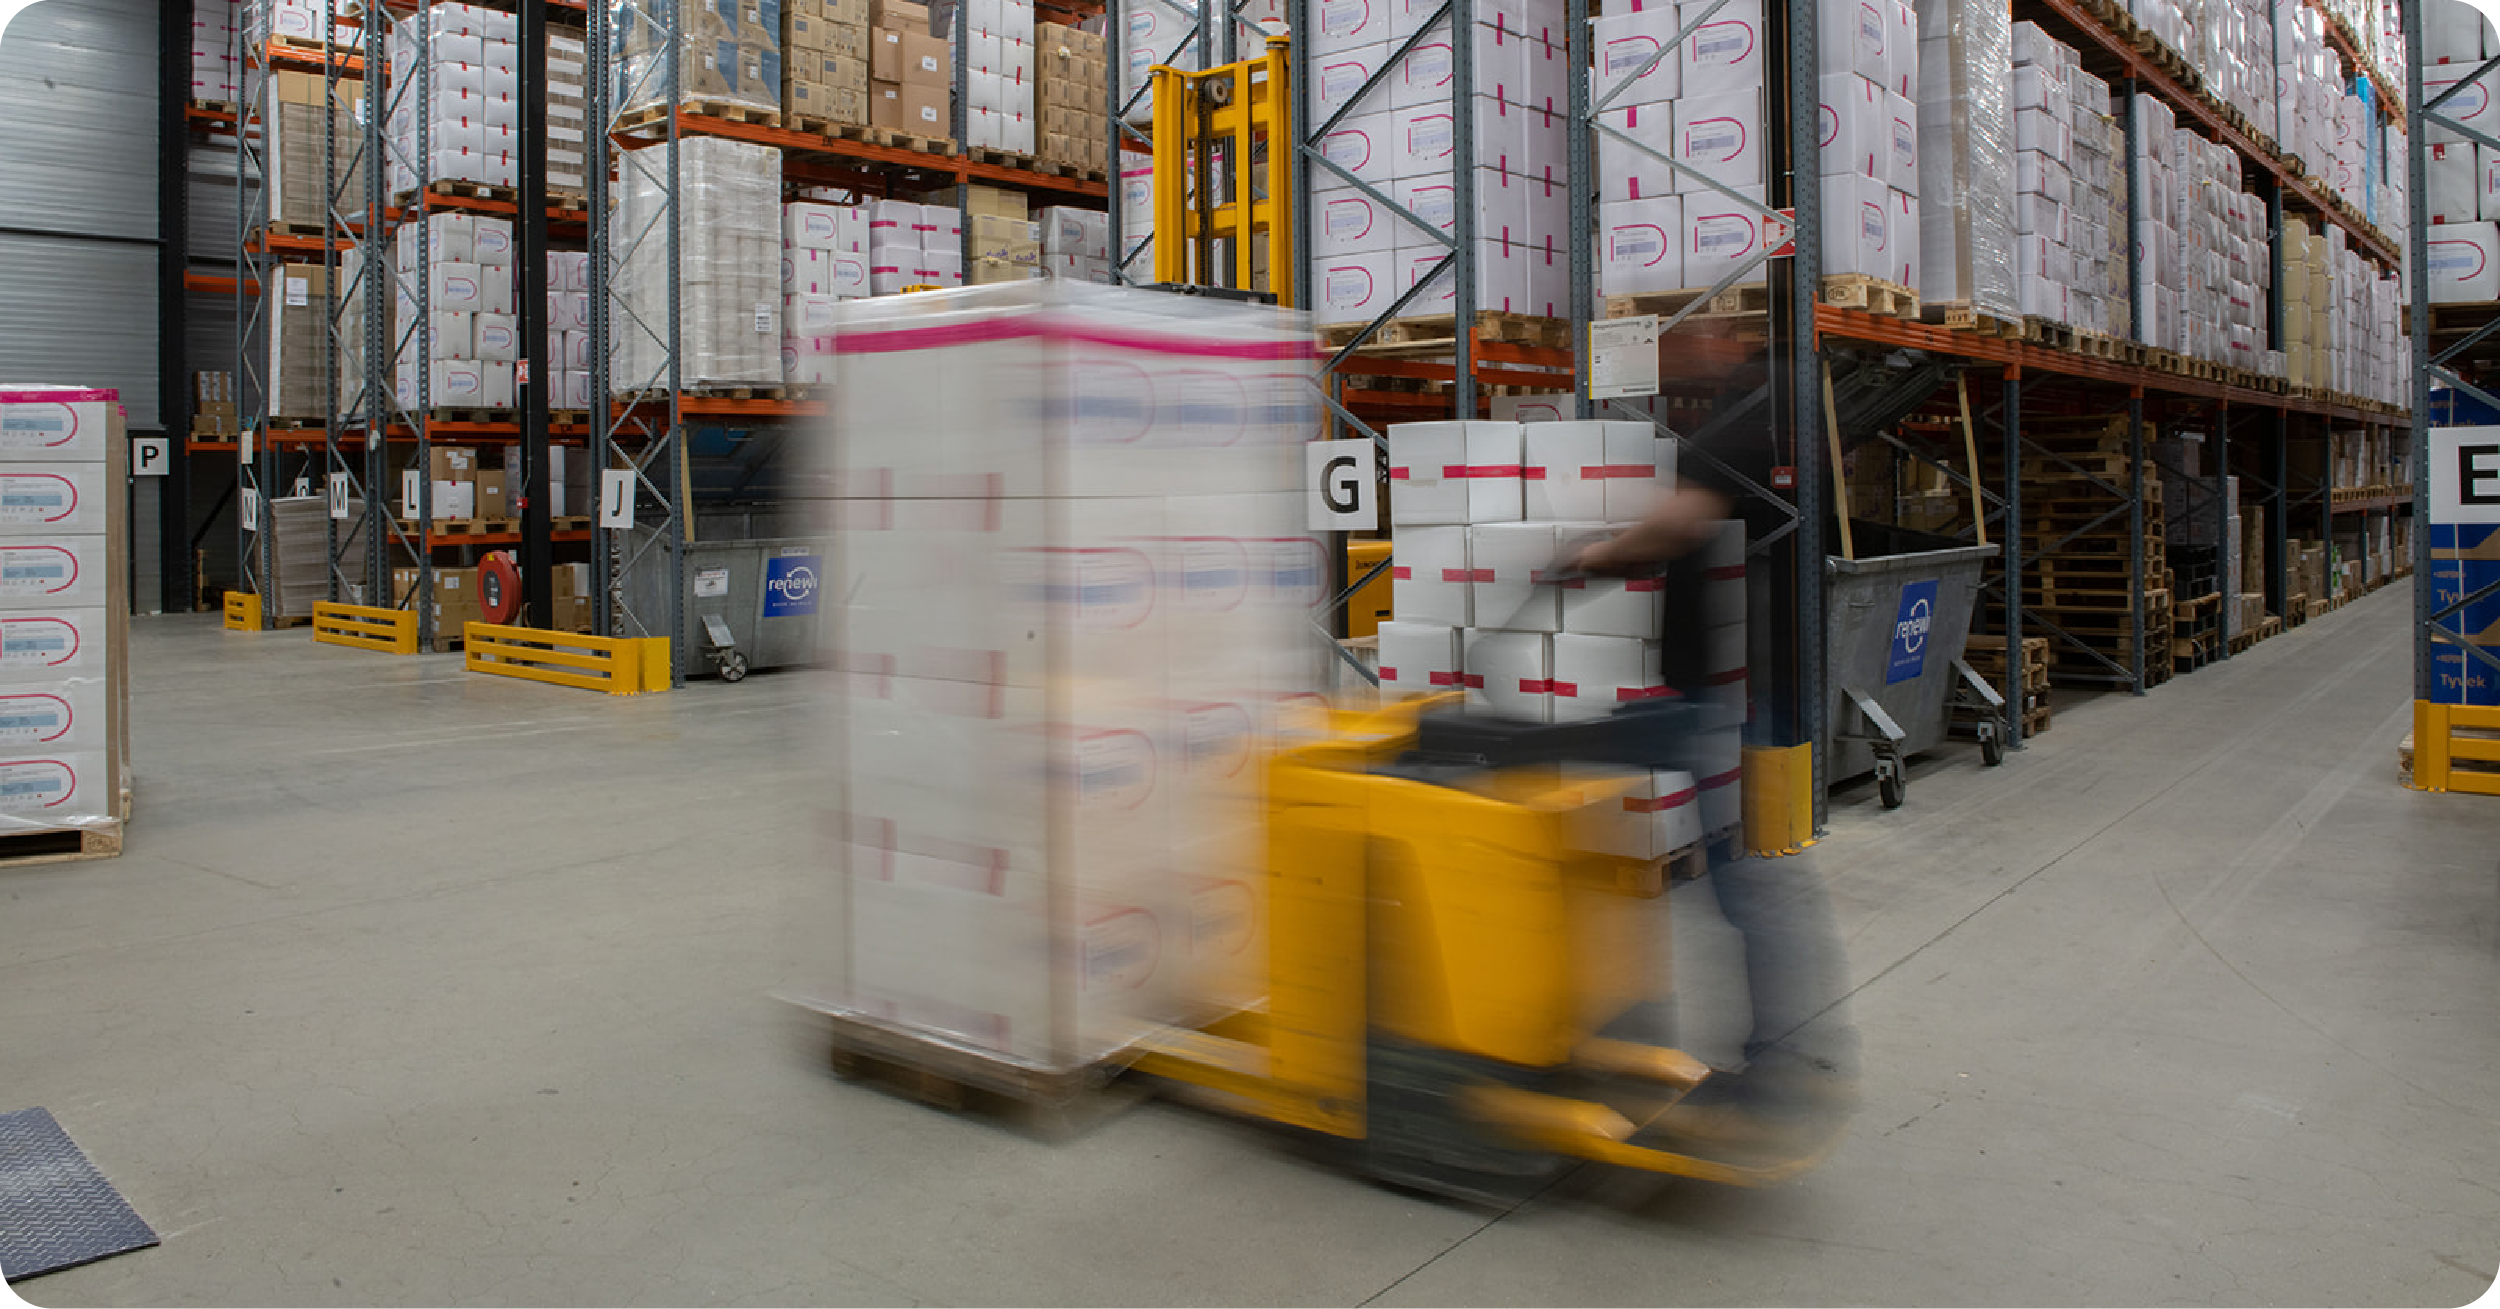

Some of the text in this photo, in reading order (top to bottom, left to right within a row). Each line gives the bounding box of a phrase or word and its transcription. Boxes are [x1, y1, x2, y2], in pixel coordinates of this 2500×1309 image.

[141, 445, 159, 468] P
[1321, 455, 1360, 514] G
[2458, 445, 2500, 506] E
[333, 480, 346, 511] M
[408, 478, 417, 511] L
[611, 480, 623, 517] J
